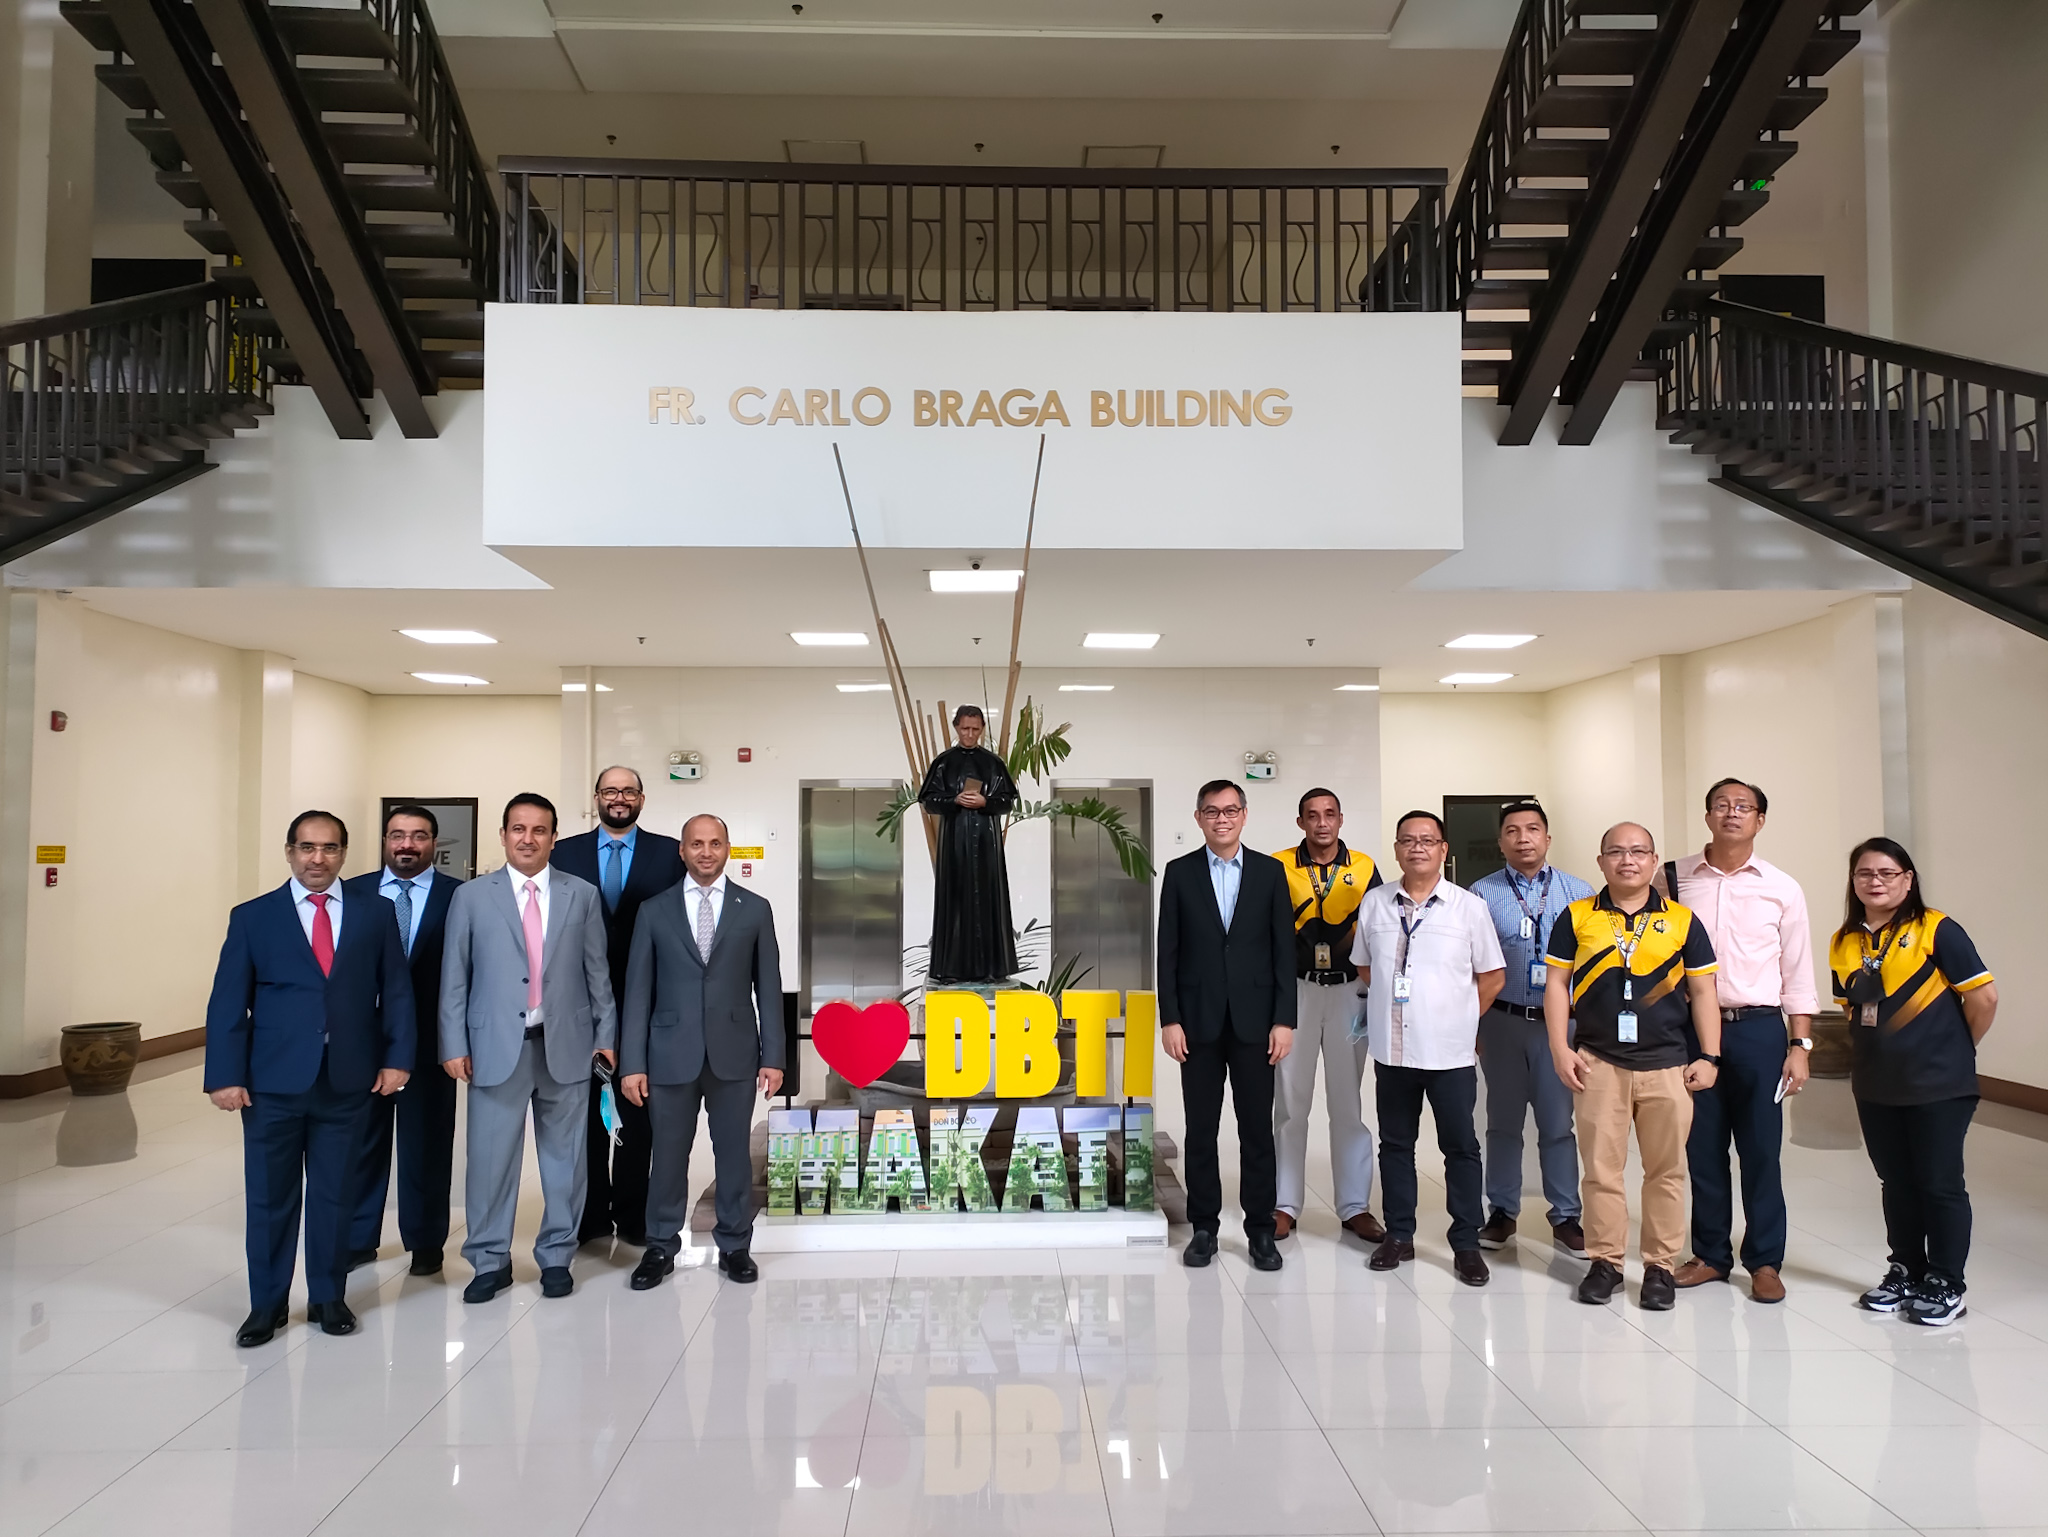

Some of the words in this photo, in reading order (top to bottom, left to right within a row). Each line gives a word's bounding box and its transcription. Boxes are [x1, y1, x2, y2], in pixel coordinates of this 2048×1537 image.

[647, 385, 706, 426] FR.
[728, 385, 891, 427] CARLO
[912, 388, 1071, 428] BRAGA
[1089, 387, 1293, 428] BUILDING
[925, 989, 1157, 1099] DBTI
[933, 1117, 949, 1126] DON
[950, 1116, 977, 1126] BOCO
[767, 1104, 1154, 1216] MAKATI
